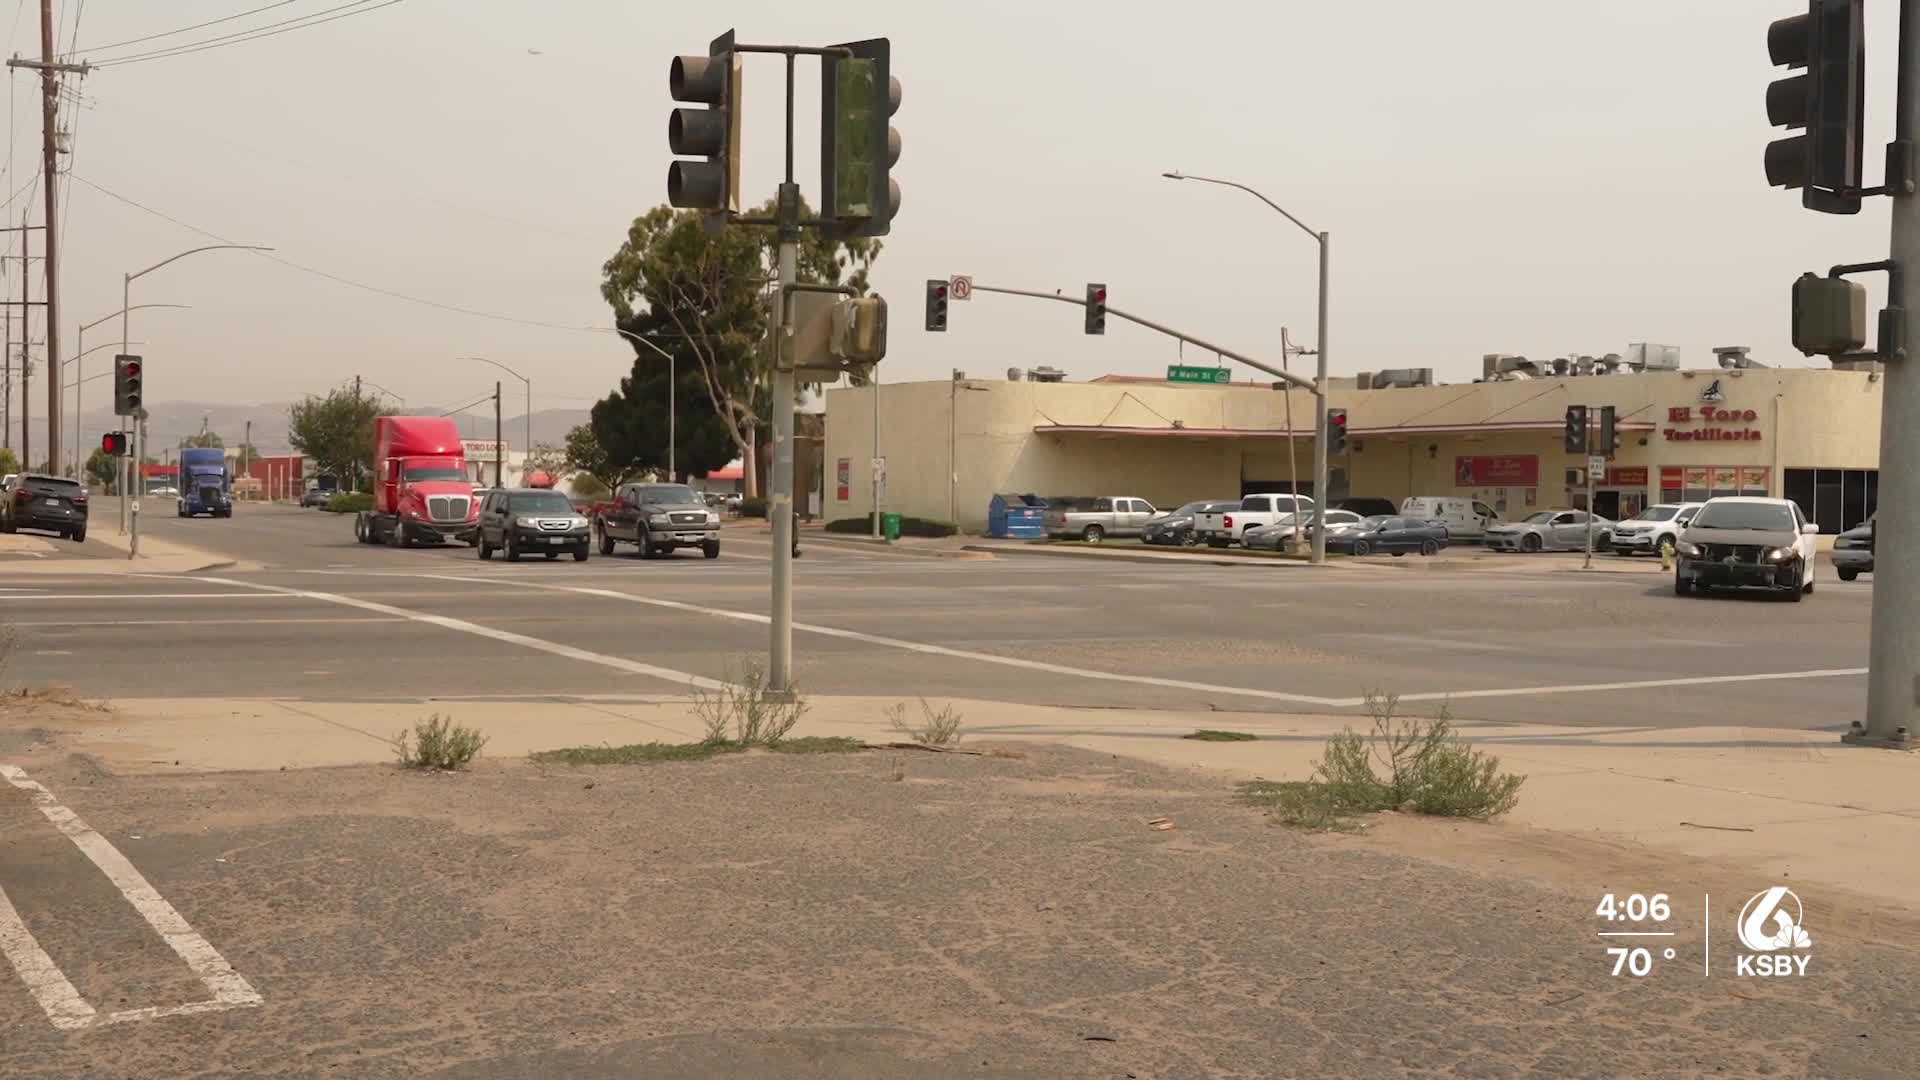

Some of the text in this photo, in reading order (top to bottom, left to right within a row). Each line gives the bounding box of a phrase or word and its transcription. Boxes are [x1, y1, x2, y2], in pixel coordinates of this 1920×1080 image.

[1180, 371, 1198, 379] Main
[1668, 407, 1757, 422] El Toro
[1663, 428, 1762, 441] Tortilleria
